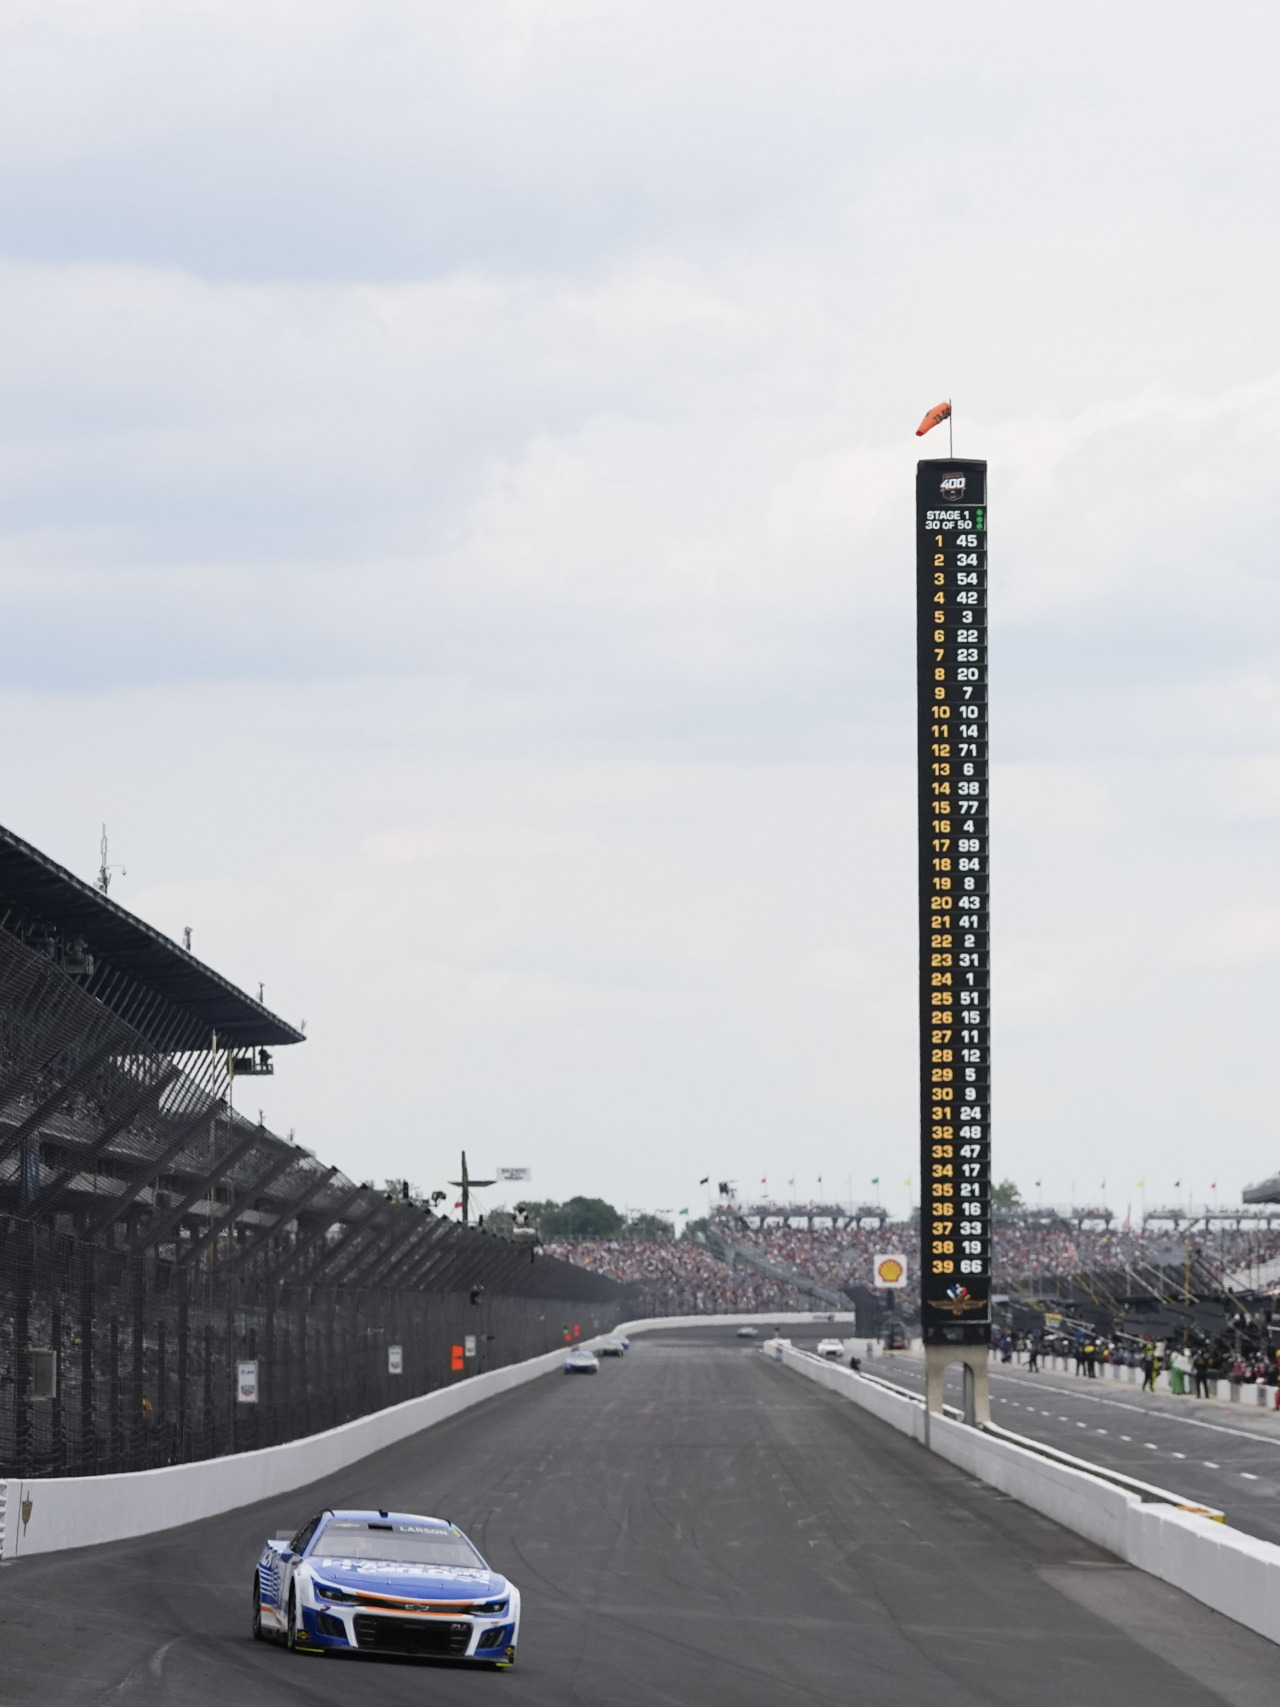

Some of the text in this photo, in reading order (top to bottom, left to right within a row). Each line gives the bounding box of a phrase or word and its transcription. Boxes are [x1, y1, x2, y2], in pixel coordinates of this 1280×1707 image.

[941, 478, 966, 489] 400
[926, 510, 970, 520] STAGE 1
[925, 520, 973, 530] 30 OF 50
[935, 534, 978, 548] 1 45
[934, 553, 978, 567] 2 34
[934, 572, 978, 586] 3 54
[933, 591, 978, 605] 4 42
[934, 610, 973, 624] 5 3
[934, 629, 979, 643] 6 22
[934, 648, 979, 662] 7 23
[934, 667, 979, 681] 8 20
[934, 686, 973, 700] 9 7
[931, 705, 979, 719] 10 10
[931, 724, 979, 738] 11 14
[931, 743, 977, 757] 12 71
[931, 762, 975, 776] 13 6
[931, 781, 980, 796] 14 38
[931, 800, 979, 815] 15 77
[932, 819, 975, 833] 16 4
[932, 838, 980, 853] 17 99
[932, 857, 980, 872] 18 84
[932, 876, 975, 891] 19 8
[930, 895, 981, 910] 20 43
[931, 914, 979, 929] 21 41
[931, 933, 975, 948] 22 2
[931, 953, 979, 967] 23 31
[931, 972, 974, 987] 24 1
[931, 991, 979, 1006] 25 51
[931, 1010, 981, 1025] 26 15
[931, 1029, 979, 1044] 27 11
[931, 1048, 981, 1063] 28 12
[931, 1067, 976, 1082] 29 5
[931, 1087, 977, 1101] 30 9
[931, 1106, 982, 1121] 31 24
[931, 1125, 982, 1140] 32 48
[931, 1144, 981, 1159] 33 47
[932, 1163, 981, 1178] 34 17
[932, 1182, 980, 1197] 35 21
[932, 1201, 982, 1216] 36 16
[932, 1221, 982, 1236] 37 33
[932, 1240, 982, 1255] 38 19
[932, 1259, 982, 1274] 39 66
[399, 1526, 448, 1536] LARSON
